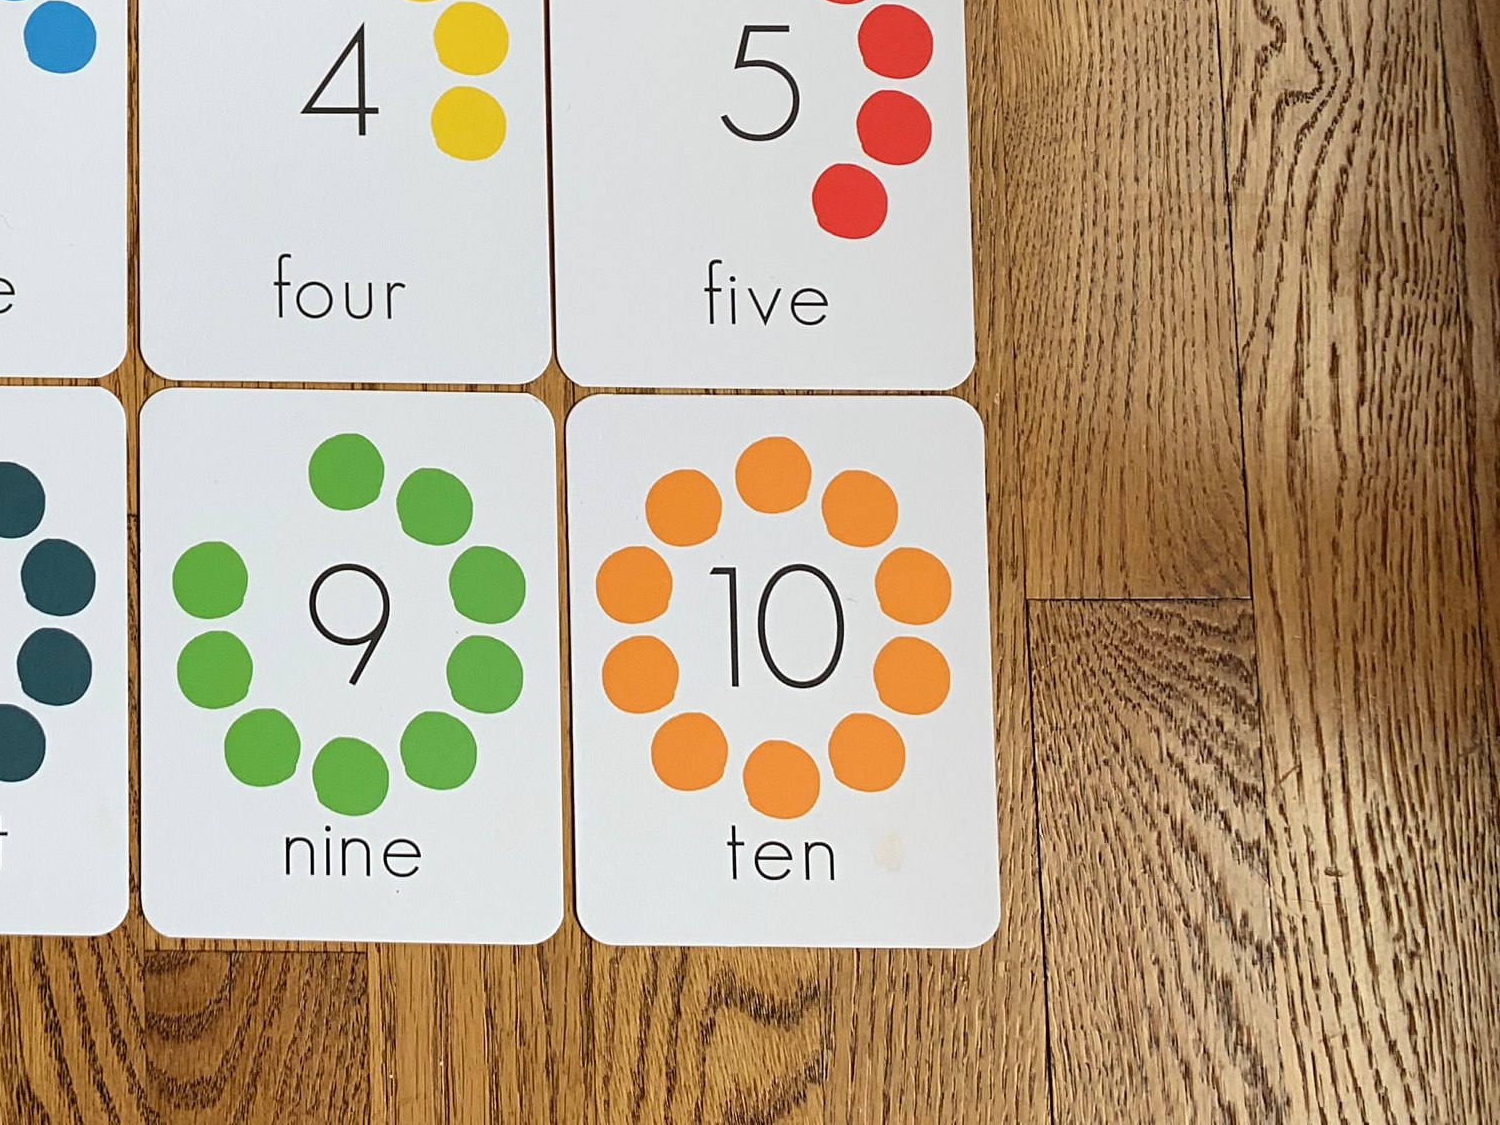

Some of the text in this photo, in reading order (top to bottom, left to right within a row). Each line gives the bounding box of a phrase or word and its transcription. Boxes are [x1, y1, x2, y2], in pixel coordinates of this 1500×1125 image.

[300, 22, 379, 136] 4
[720, 24, 800, 142] 5
[273, 253, 406, 320] four
[703, 259, 829, 326] five
[308, 563, 391, 686] 9
[709, 563, 845, 689] 10
[285, 824, 422, 878] nine
[726, 824, 835, 881] ten
